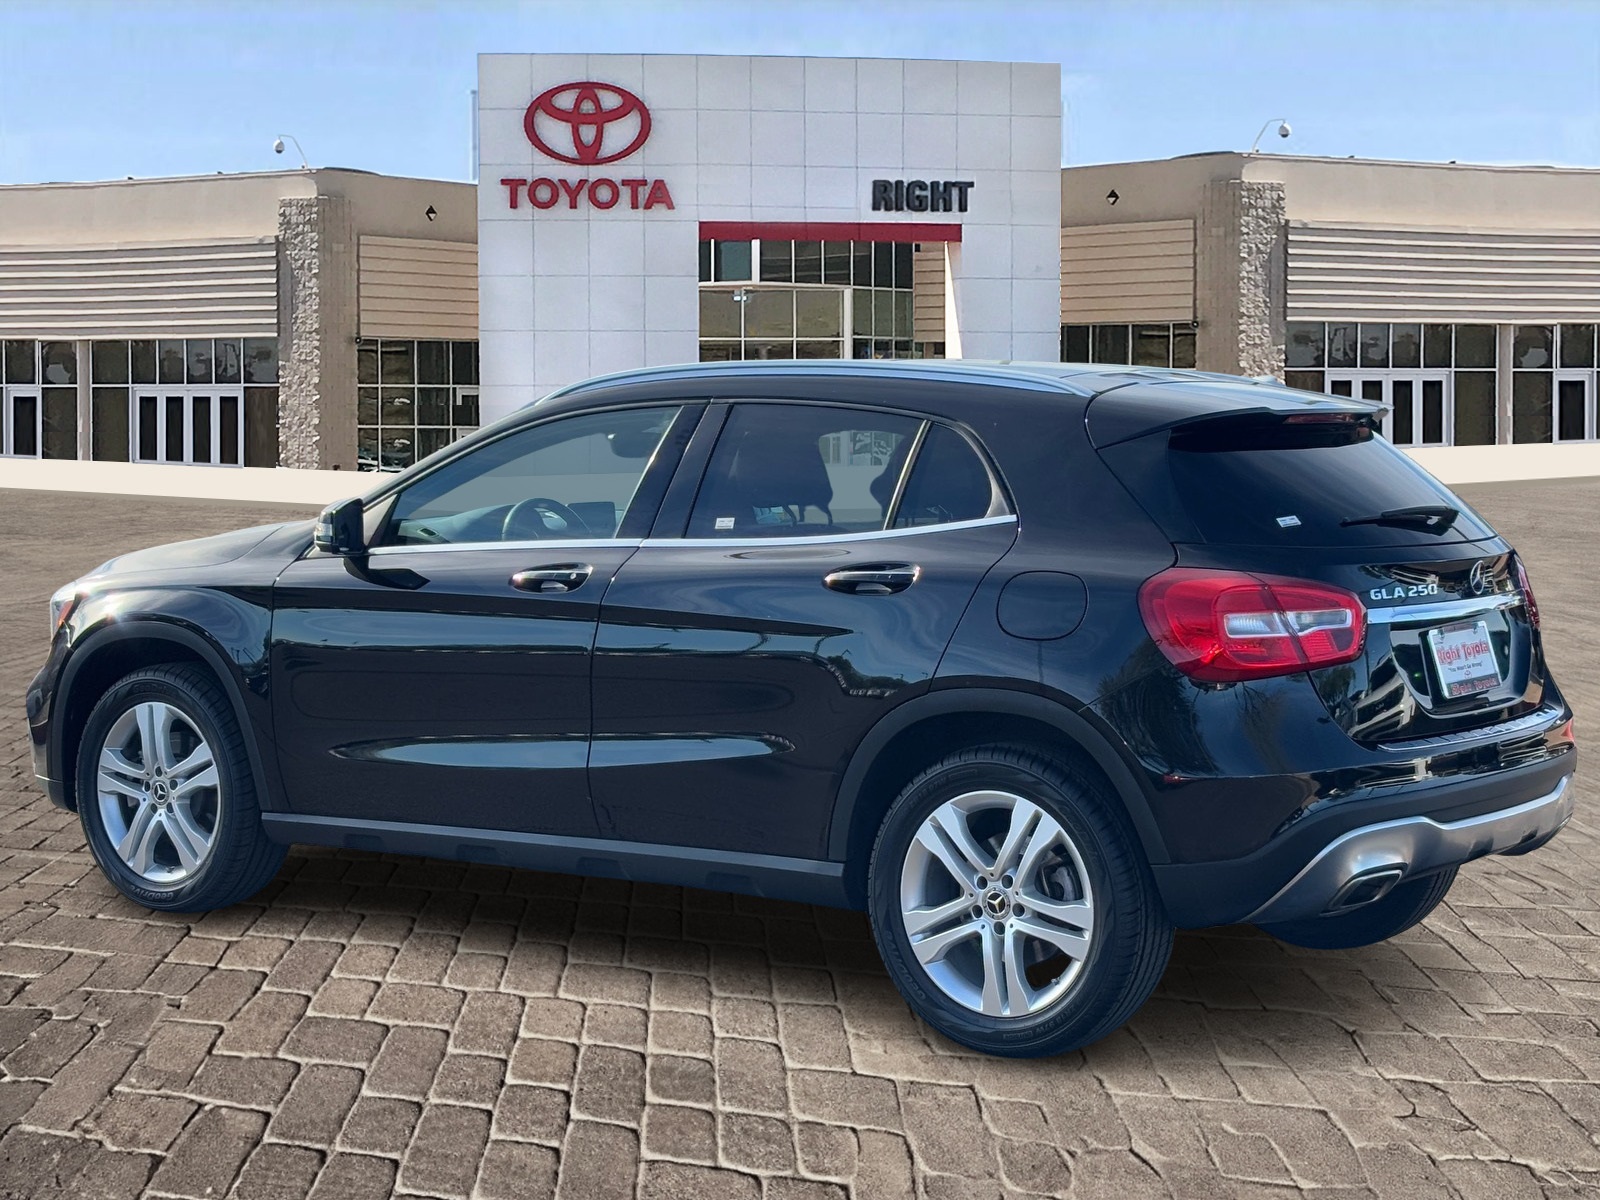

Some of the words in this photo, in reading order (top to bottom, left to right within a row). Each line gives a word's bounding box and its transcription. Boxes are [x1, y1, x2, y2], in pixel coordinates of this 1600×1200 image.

[500, 177, 676, 210] TOYOTA
[871, 178, 976, 213] RIGHT
[1370, 586, 1406, 601] GLA
[1408, 583, 1438, 597] 250
[1436, 645, 1461, 666] Right
[1461, 640, 1490, 661] Toyota
[1473, 677, 1498, 691] Toyota
[130, 884, 174, 901] GeoDrive
